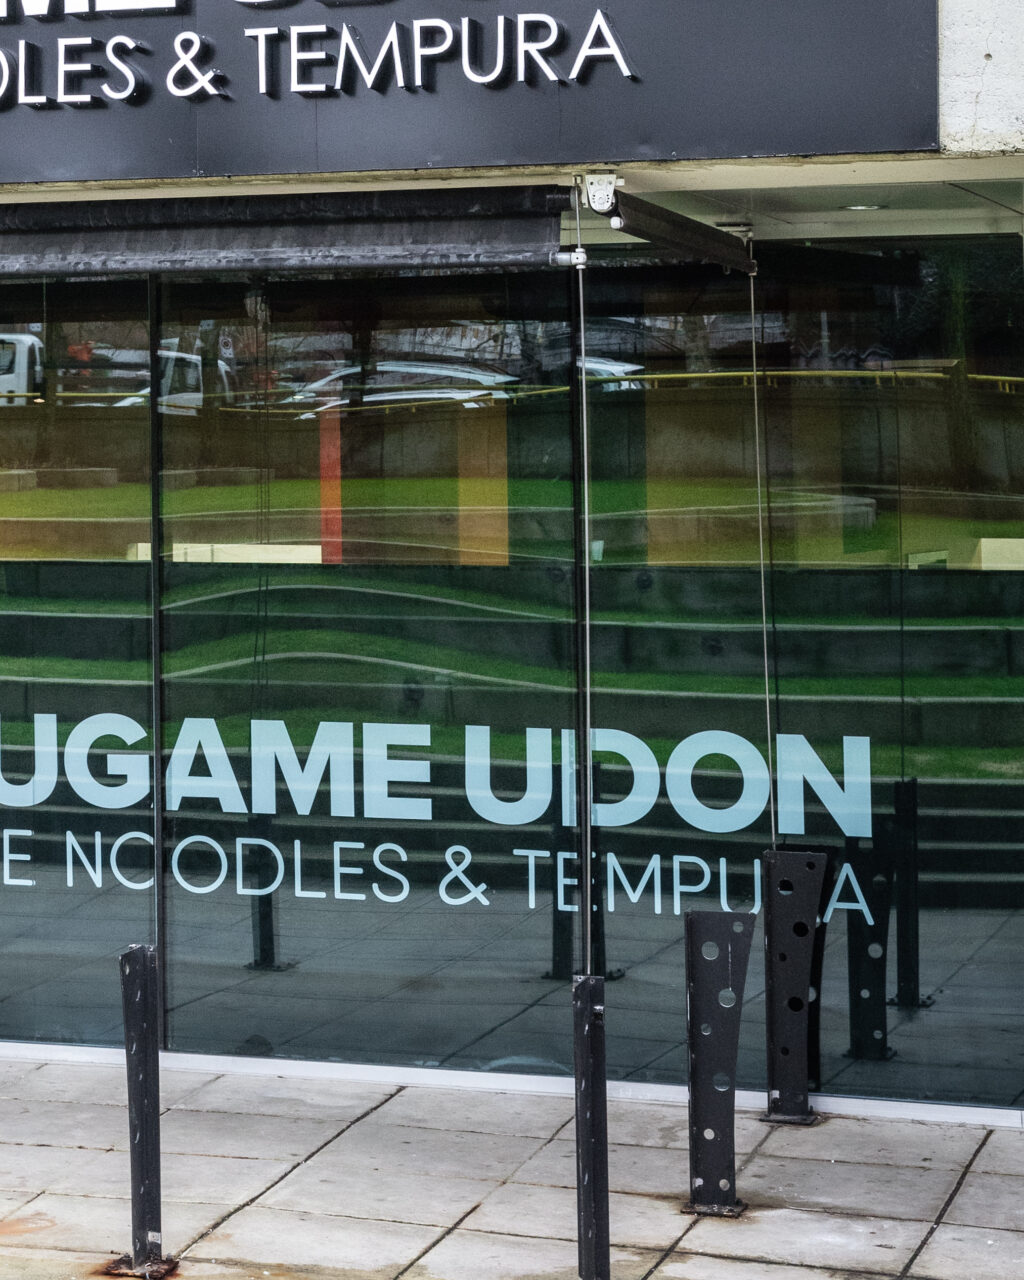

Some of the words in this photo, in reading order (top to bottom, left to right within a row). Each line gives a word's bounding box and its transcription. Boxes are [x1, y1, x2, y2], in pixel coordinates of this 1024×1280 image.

[166, 30, 219, 97] &
[244, 8, 632, 96] TEMPURA
[464, 724, 874, 838] UDON
[66, 830, 410, 903] NOODLES
[438, 844, 491, 907] &
[512, 848, 876, 926] TEMPUA
